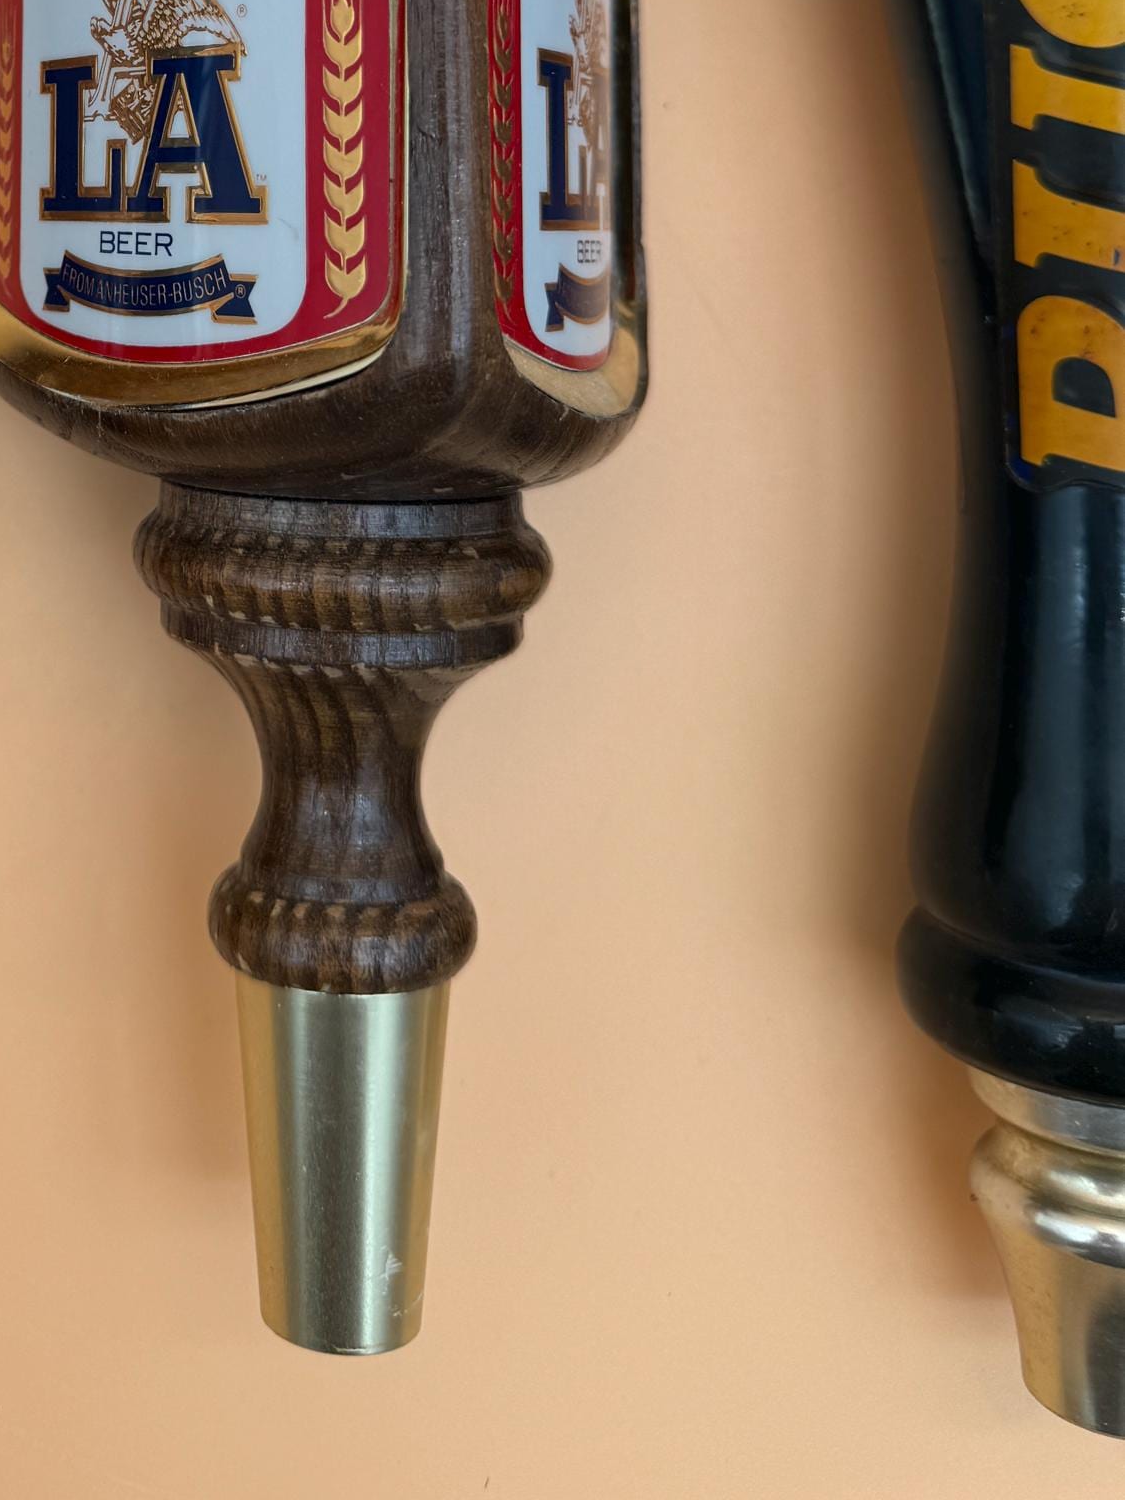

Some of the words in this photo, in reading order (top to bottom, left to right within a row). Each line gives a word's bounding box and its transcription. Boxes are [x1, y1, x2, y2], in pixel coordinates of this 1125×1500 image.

[39, 41, 269, 224] LA
[98, 230, 174, 257] BEER
[62, 263, 95, 296] FROM
[95, 267, 227, 307] ANHEUSER-BUSCH
